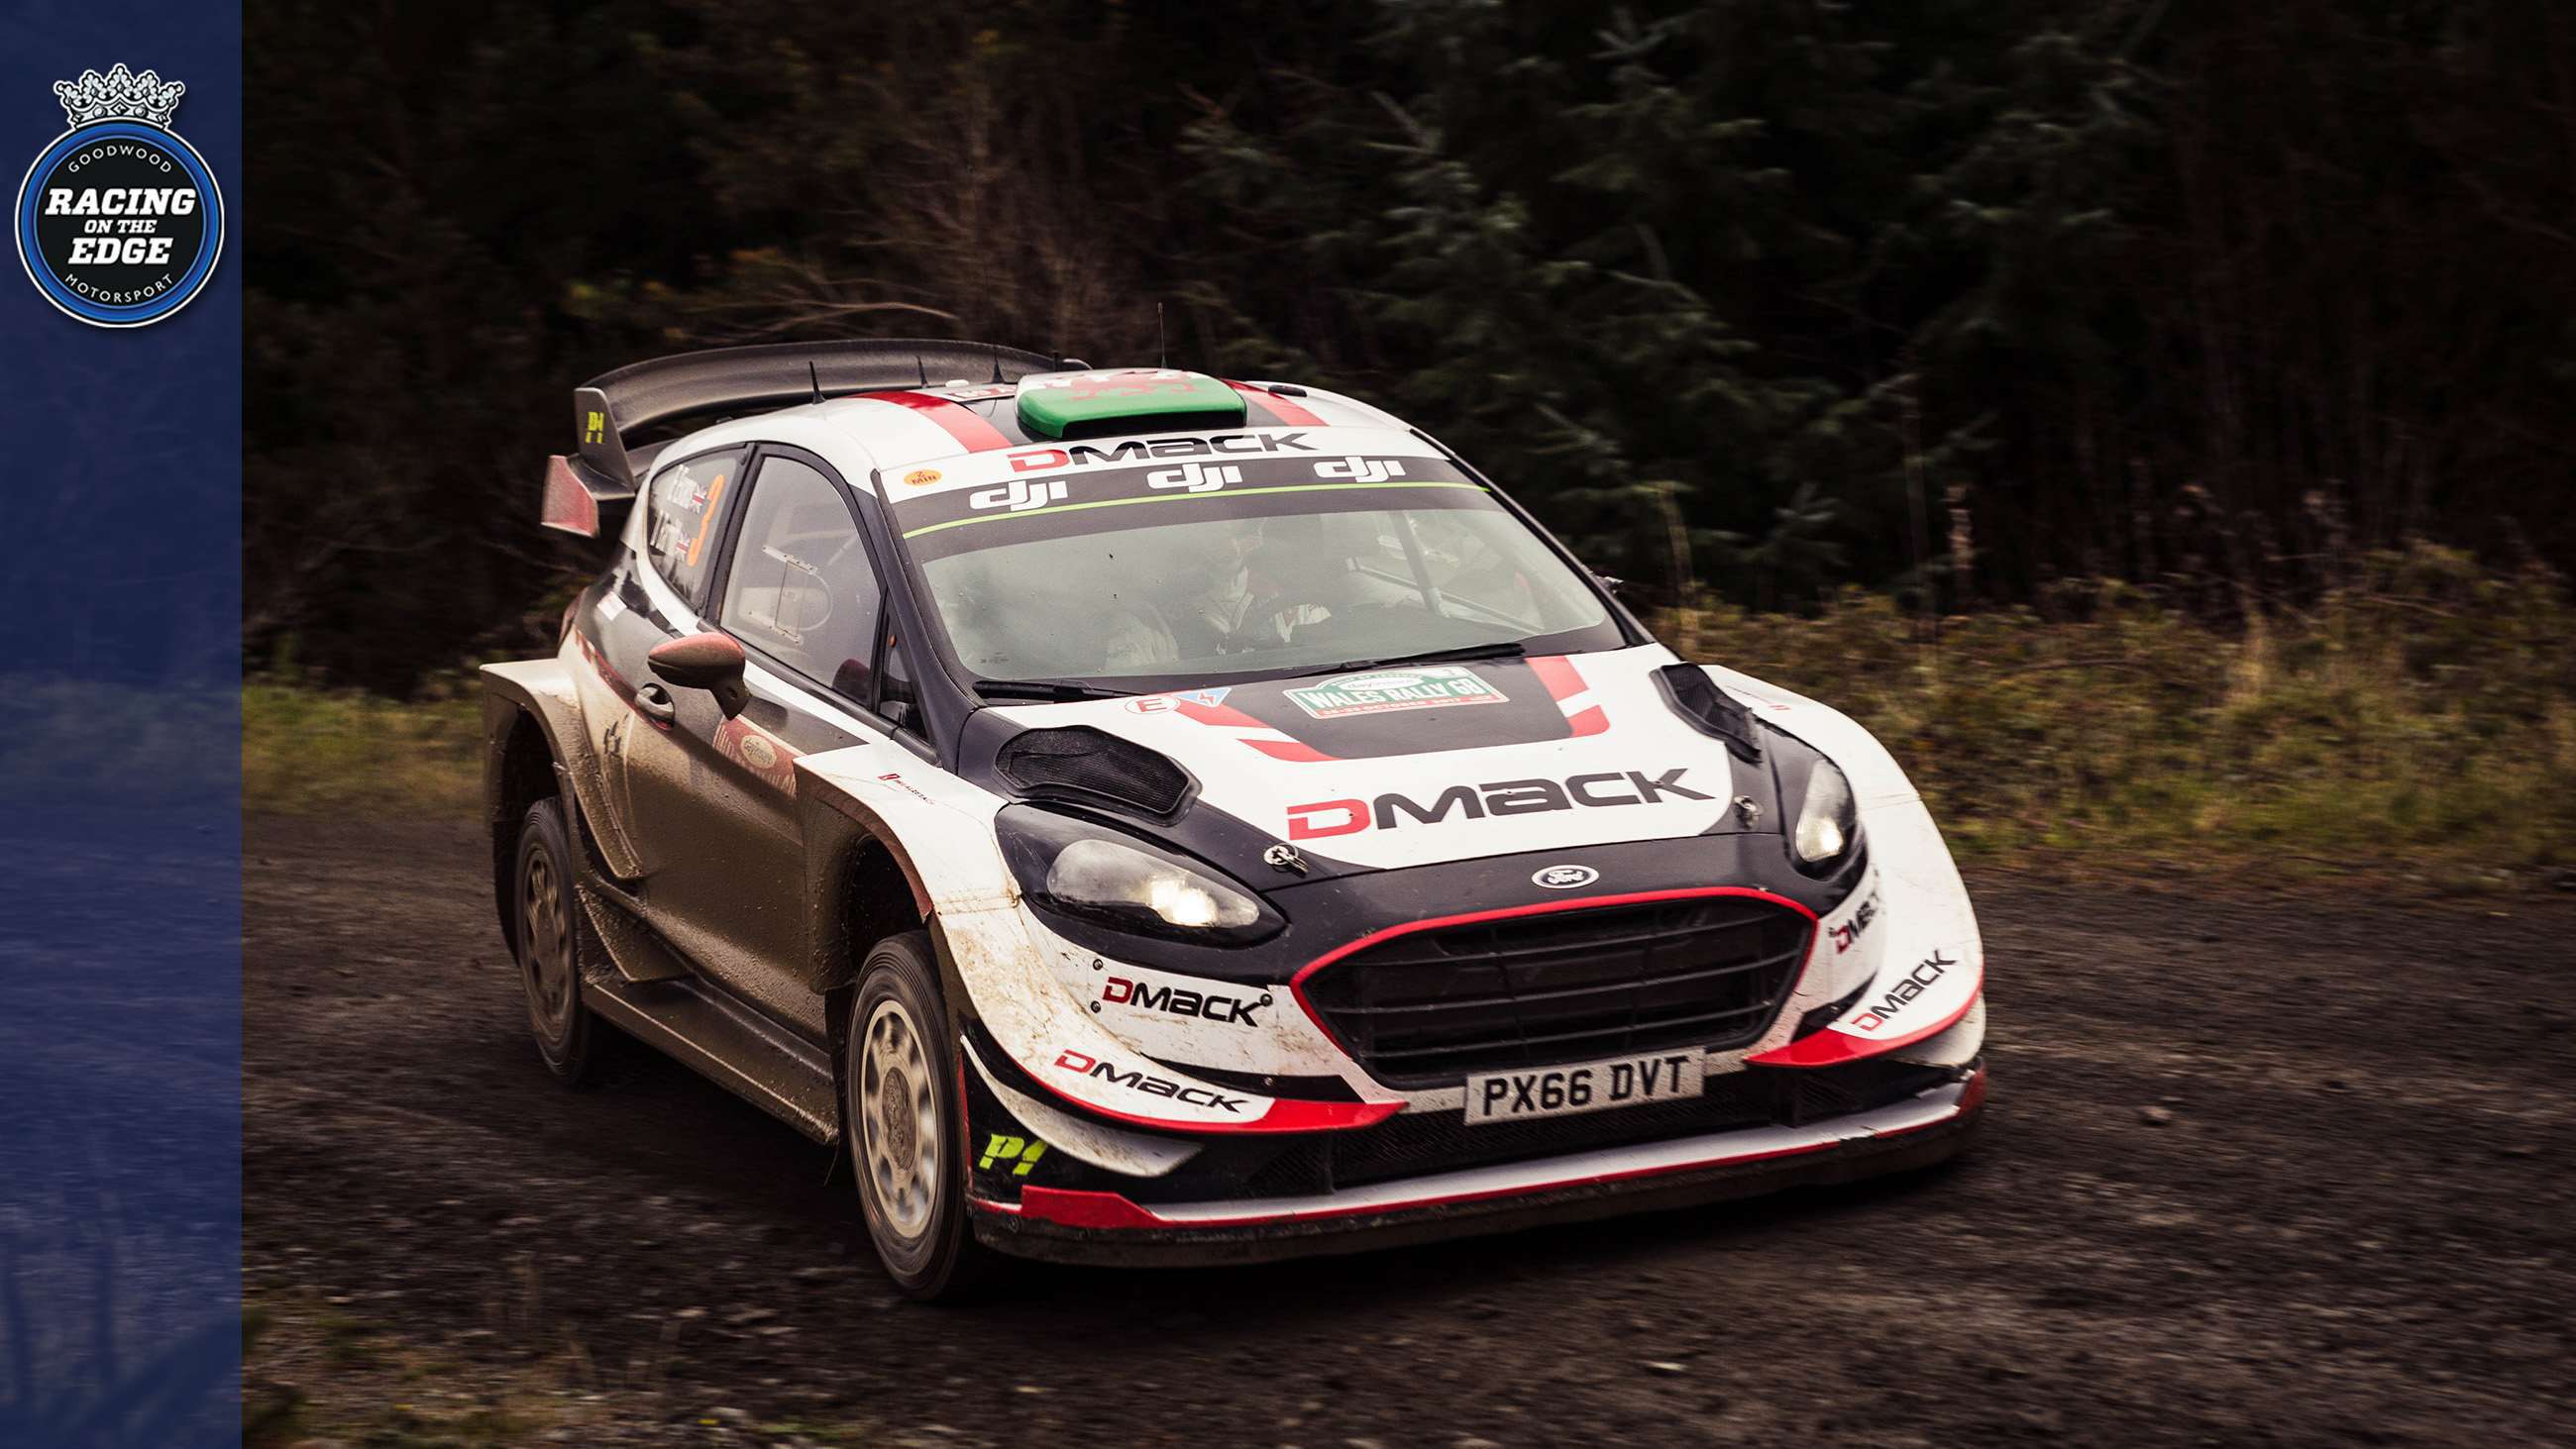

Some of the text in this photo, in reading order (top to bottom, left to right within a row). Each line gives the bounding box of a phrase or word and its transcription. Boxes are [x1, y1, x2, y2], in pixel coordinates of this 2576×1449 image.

[1146, 463, 1242, 492] dji
[1313, 457, 1406, 483] dji
[970, 480, 1068, 512] dji
[1136, 698, 1167, 712] E
[1303, 677, 1487, 709] WALES RALLY GB
[1482, 1055, 1690, 1116] PX66 DVT
